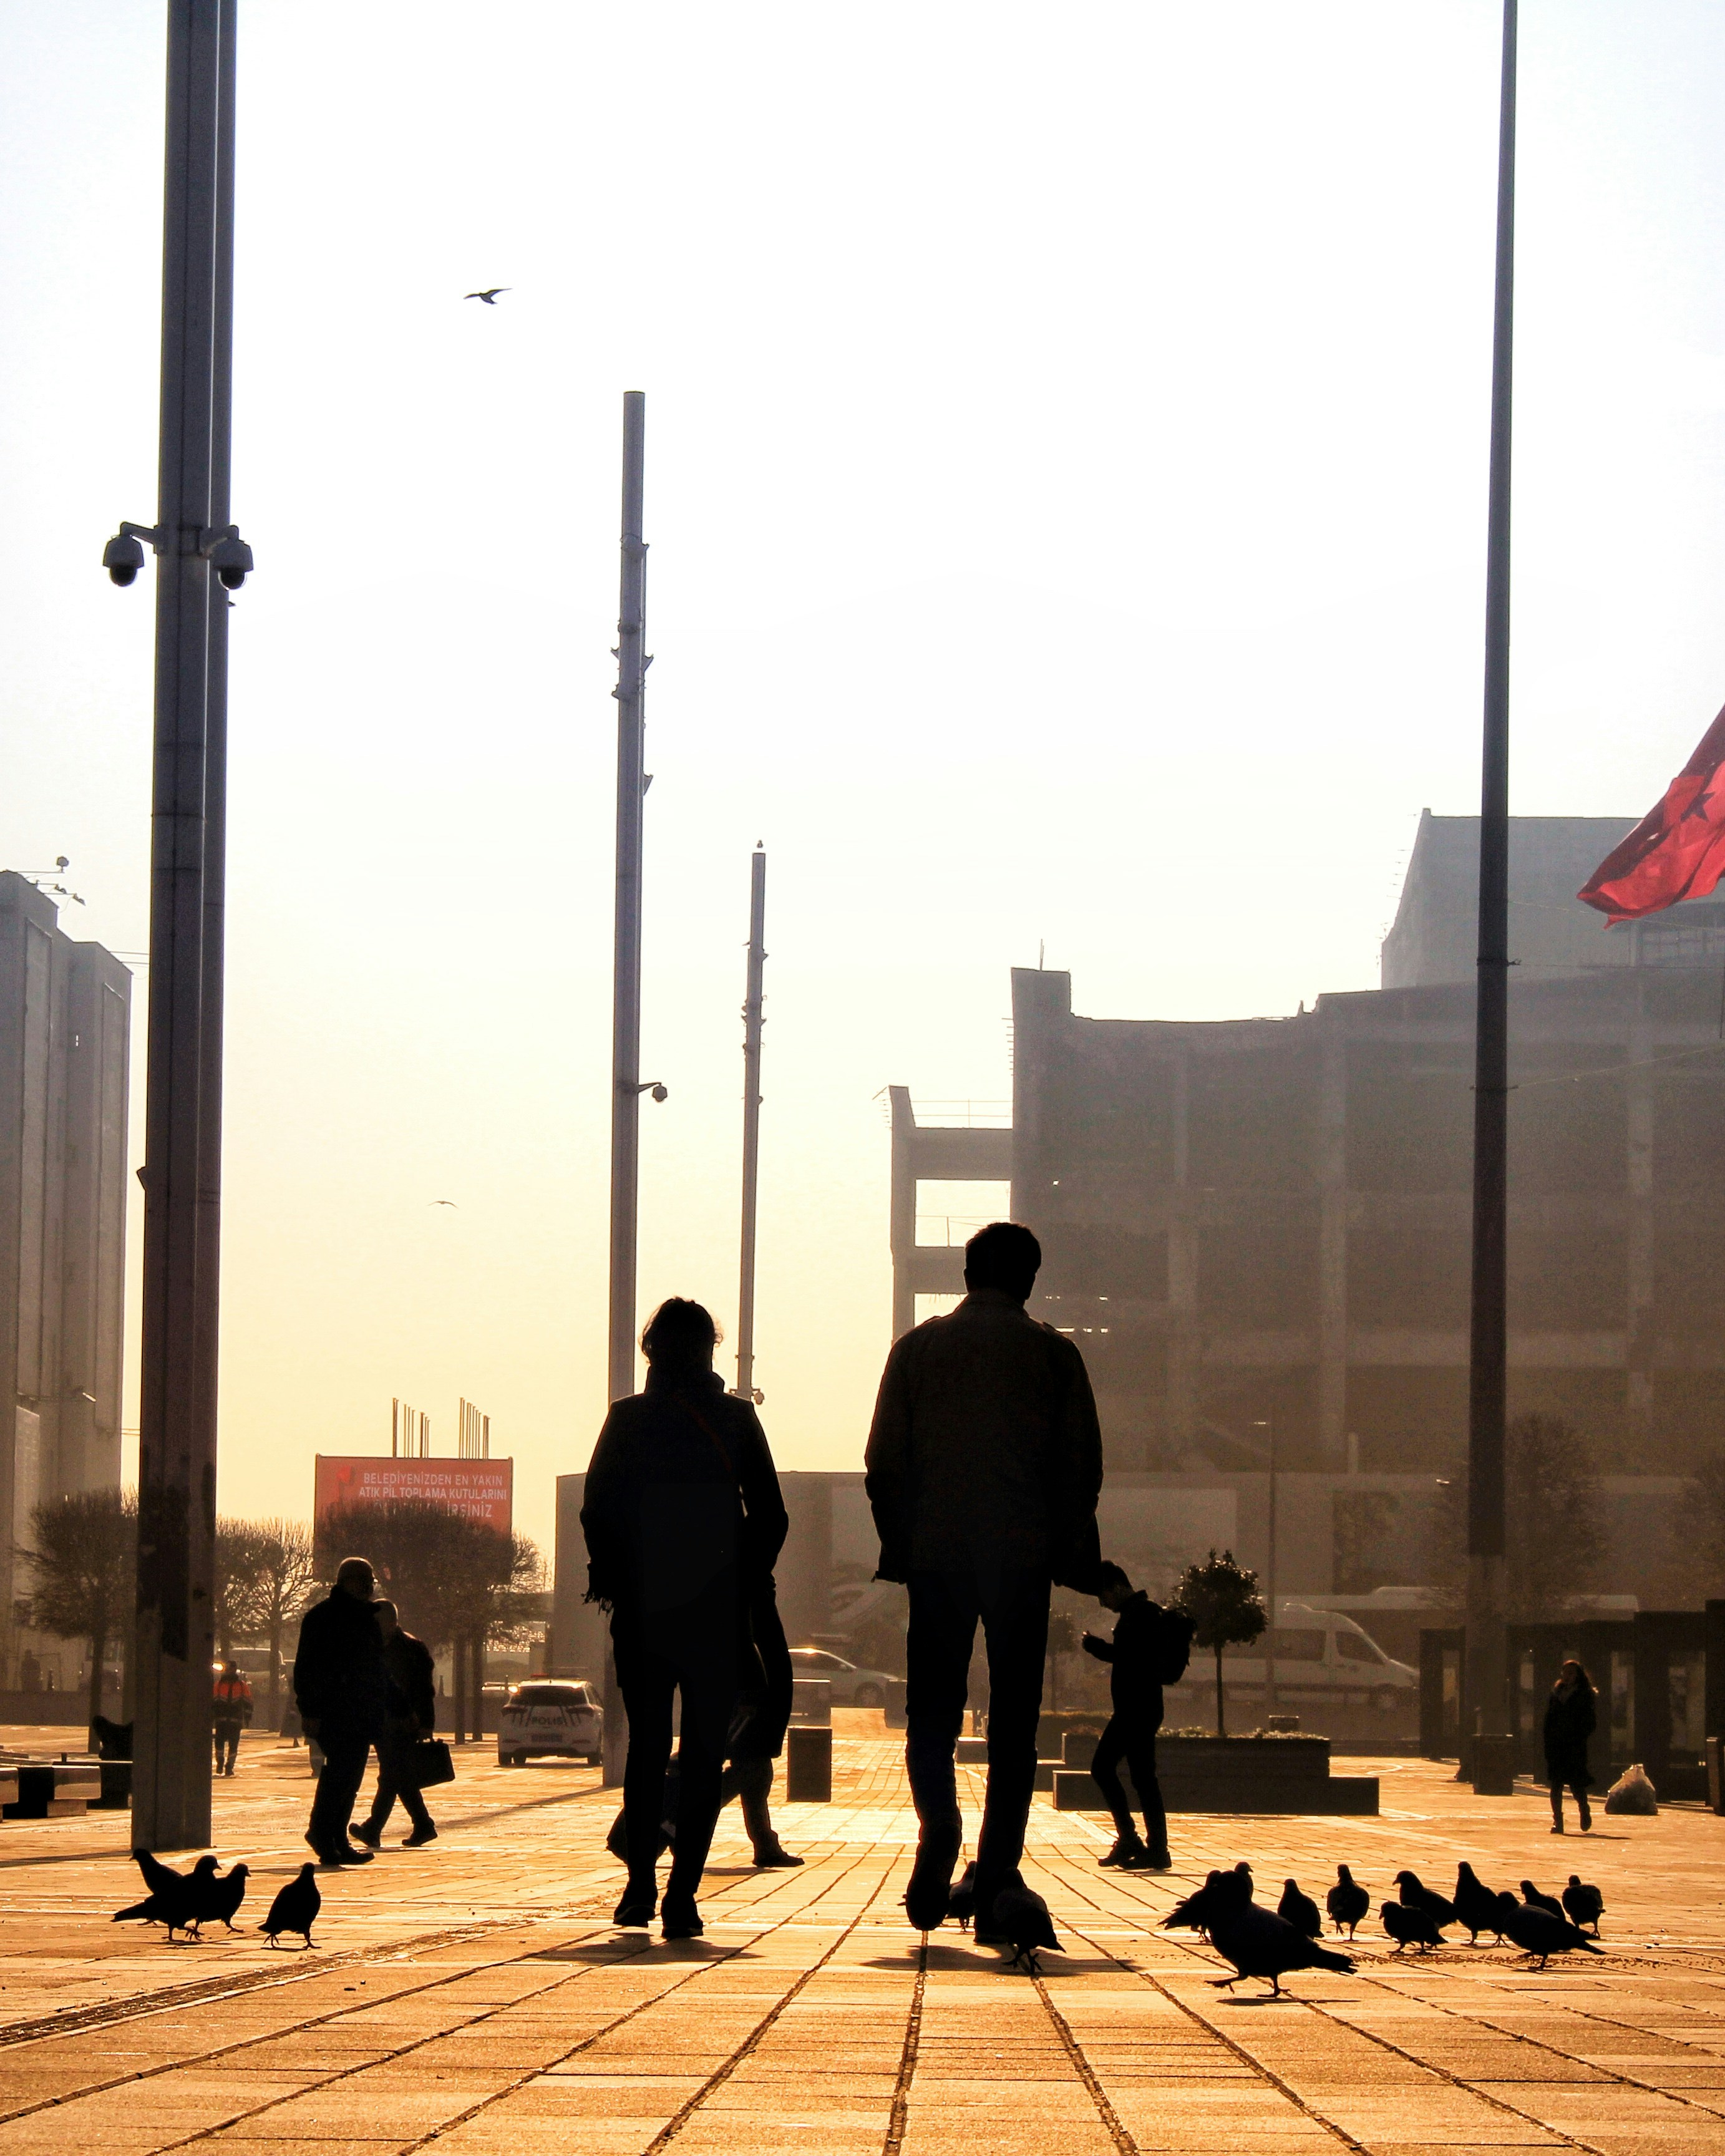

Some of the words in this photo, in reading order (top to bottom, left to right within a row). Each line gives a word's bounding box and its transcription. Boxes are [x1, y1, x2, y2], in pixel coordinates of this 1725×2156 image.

[364, 1472, 452, 1485] BELEDİYENİZDEN
[455, 1475, 469, 1485] EN
[472, 1475, 503, 1487] YAKIN
[359, 1487, 380, 1498] ATIK
[383, 1484, 397, 1498] PİL
[400, 1487, 447, 1498] TOPLAMA
[449, 1487, 507, 1500] KUTULARINI
